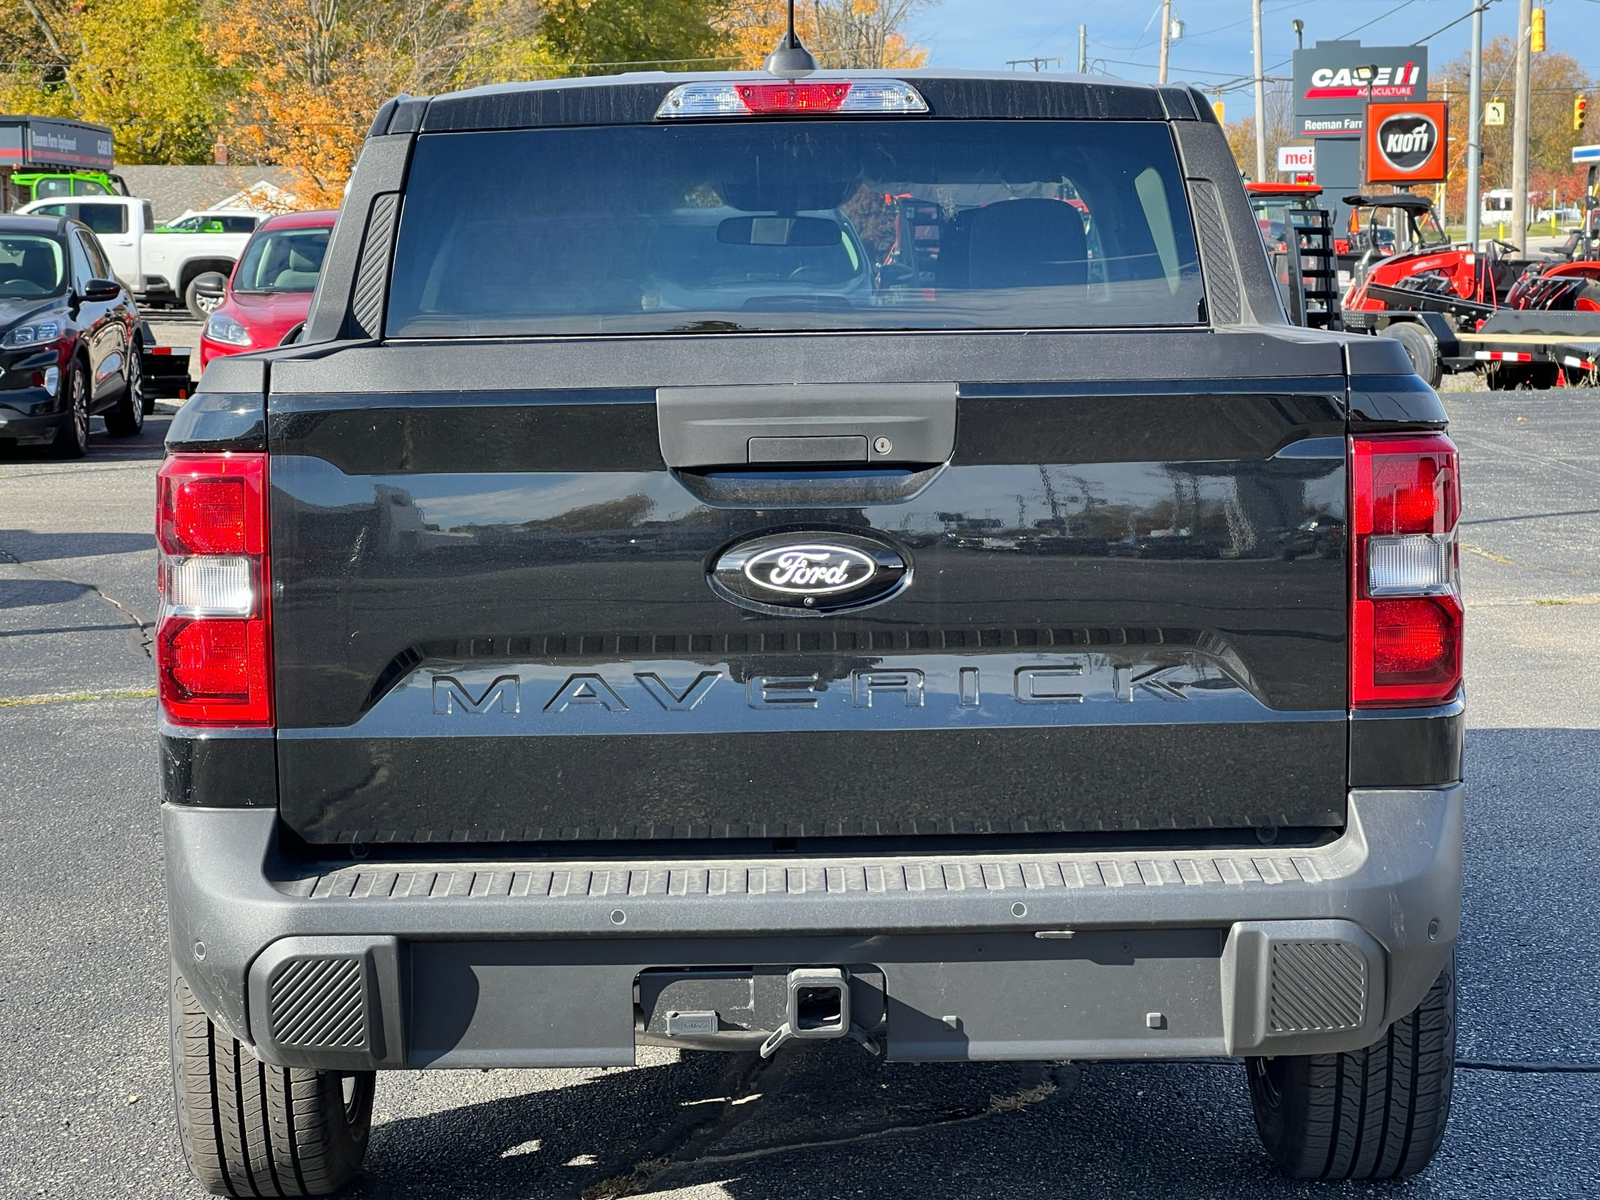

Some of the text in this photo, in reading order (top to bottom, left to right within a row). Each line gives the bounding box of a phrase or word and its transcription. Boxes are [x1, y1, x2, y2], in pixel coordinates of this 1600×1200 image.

[1357, 86, 1411, 96] AGICULTURE
[1304, 119, 1342, 130] Reeman
[1386, 132, 1429, 153] KIOTI
[769, 551, 850, 585] Ford
[431, 663, 1189, 715] MAVERICK
